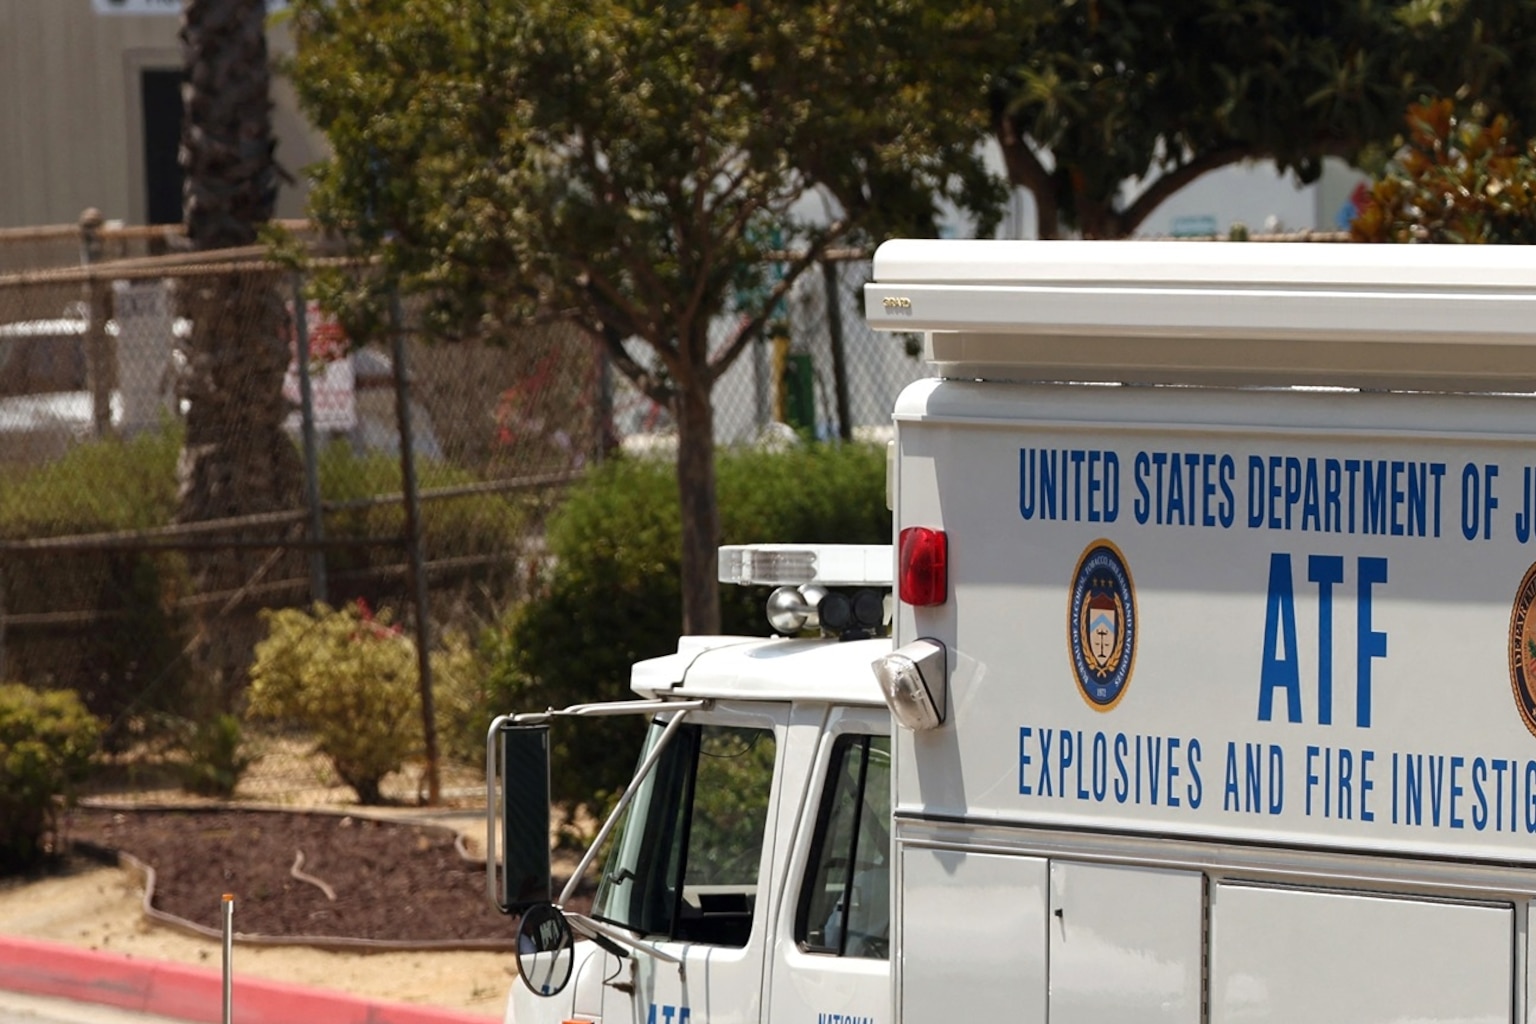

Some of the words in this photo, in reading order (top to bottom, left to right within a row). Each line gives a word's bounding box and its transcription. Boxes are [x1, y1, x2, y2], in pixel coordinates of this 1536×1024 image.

[1019, 448, 1119, 523] UNITED
[1133, 451, 1234, 529] STATES
[1248, 455, 1446, 538] DEPARTMENT
[1461, 463, 1499, 541] OF
[1257, 552, 1388, 728] ATF
[1019, 726, 1203, 809] EXPLOSIVES
[1224, 742, 1284, 815] AND
[1306, 745, 1375, 822] FIRE
